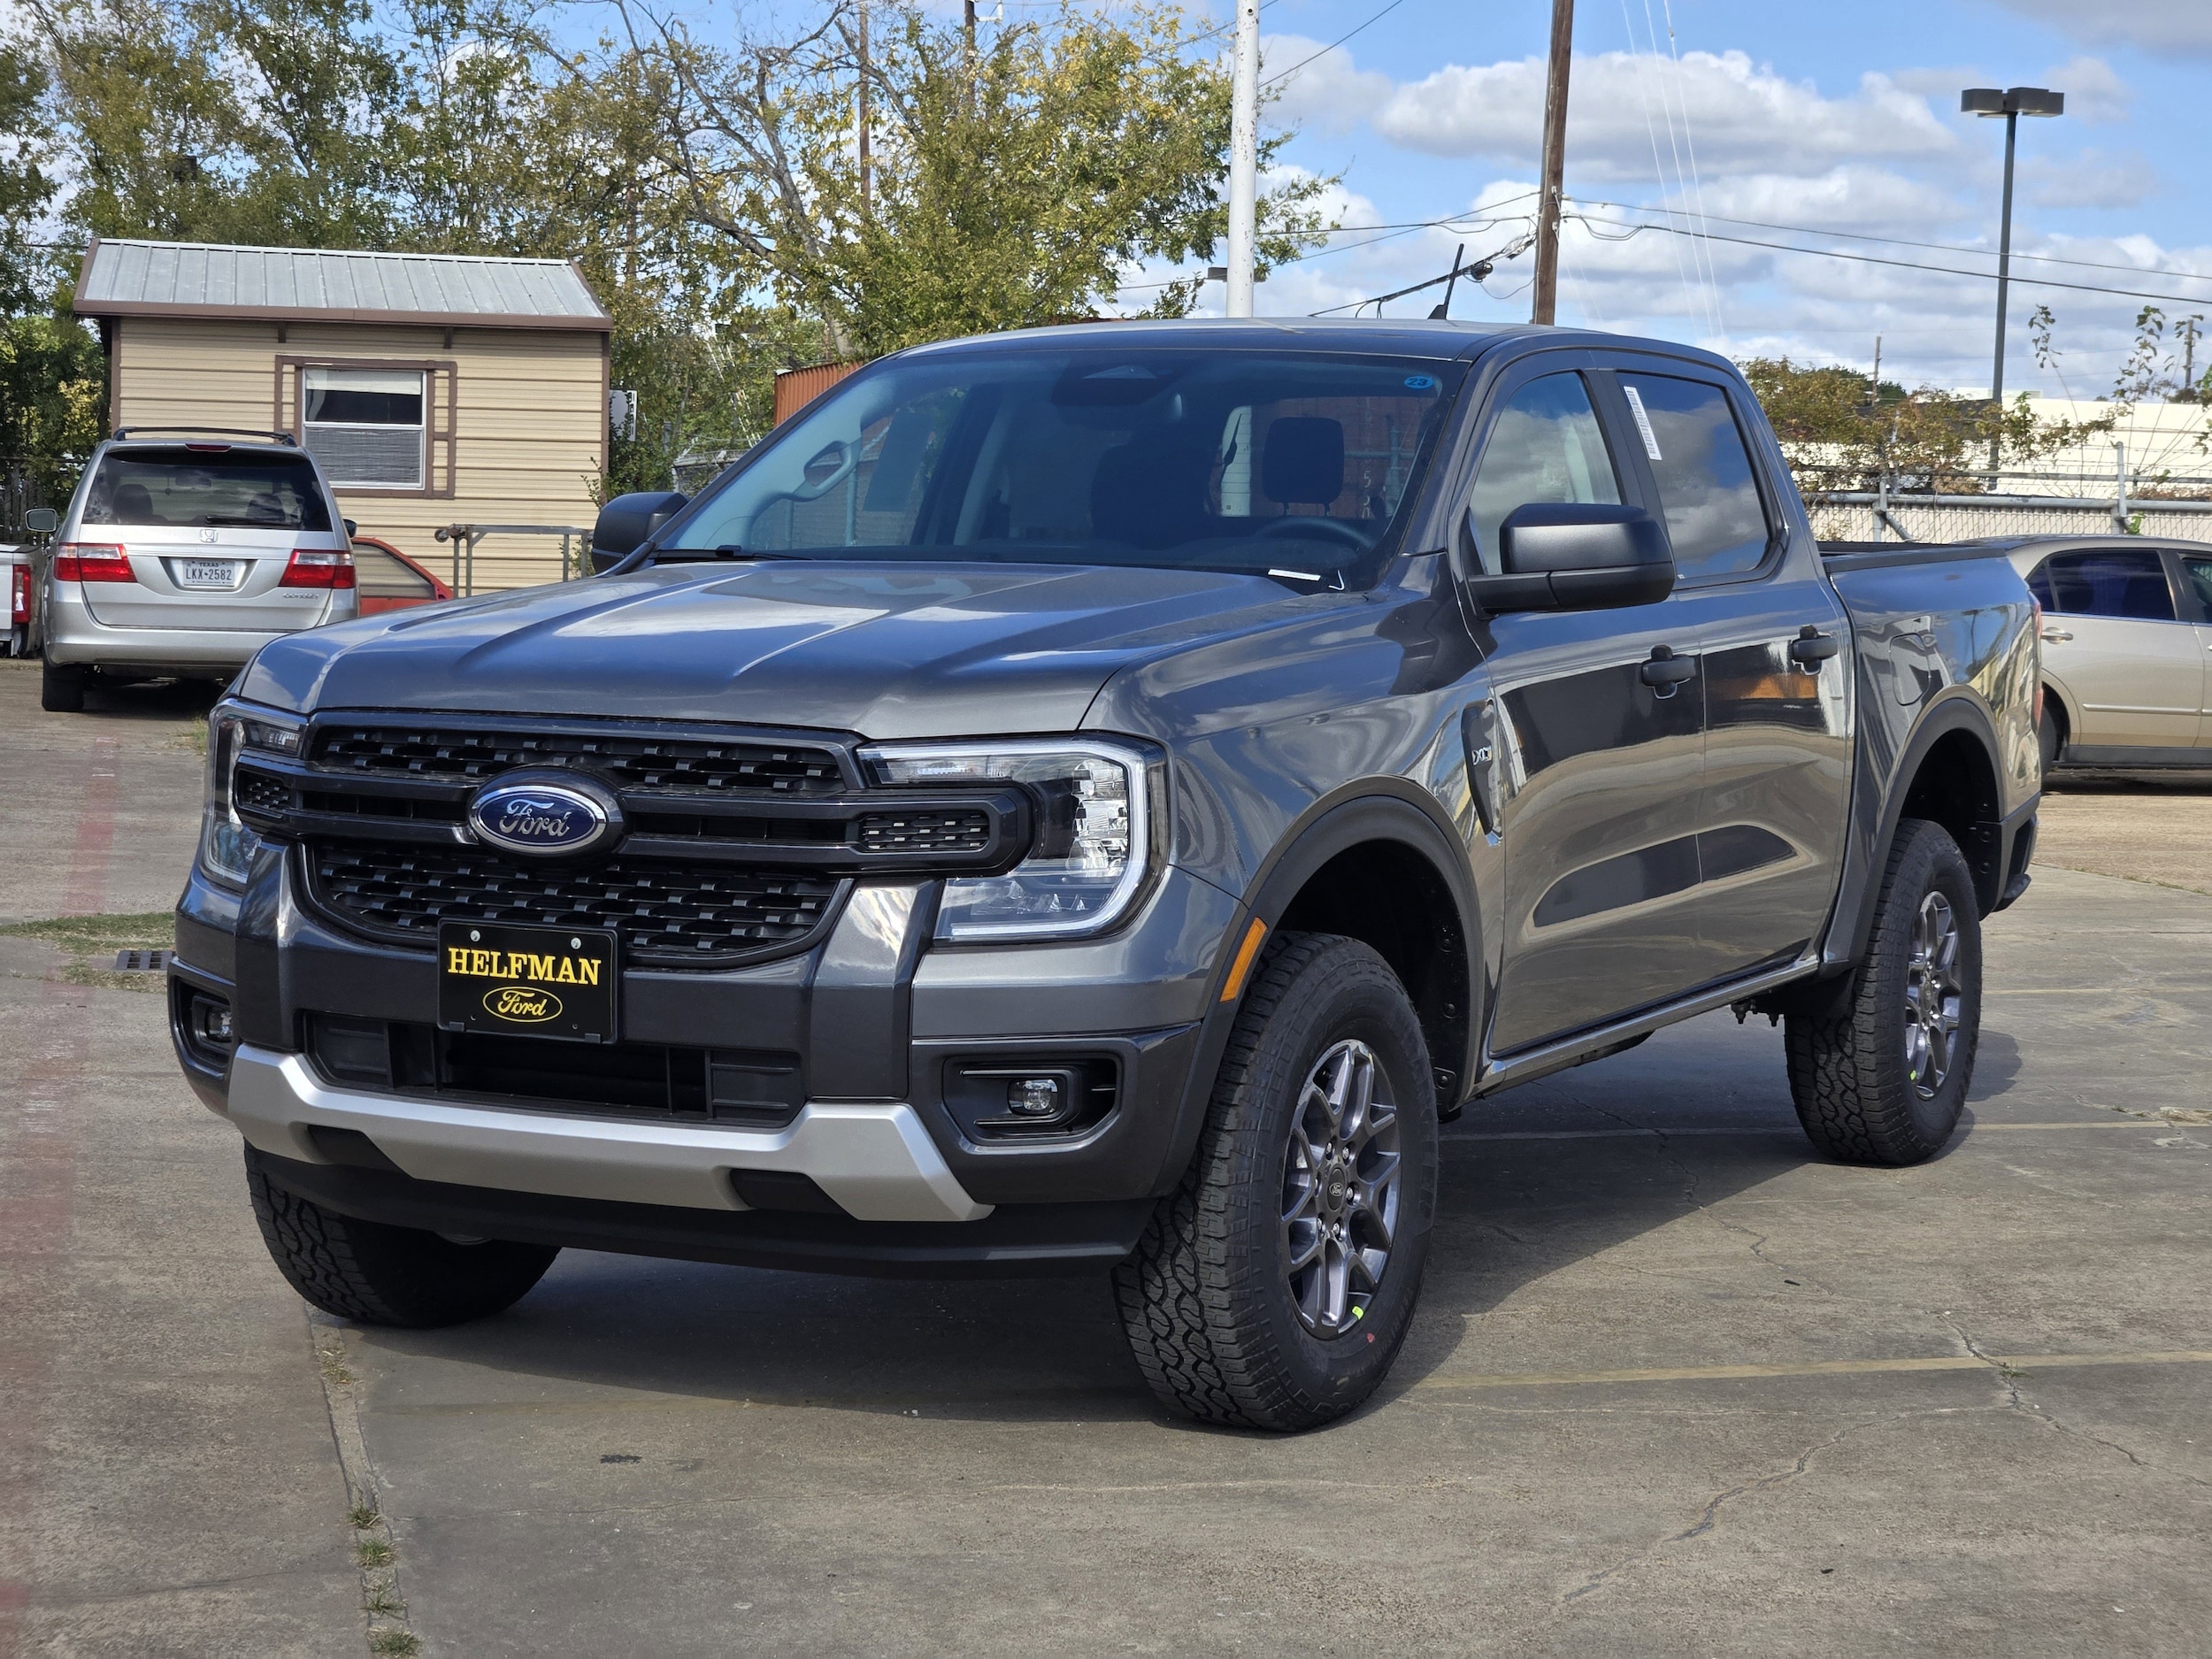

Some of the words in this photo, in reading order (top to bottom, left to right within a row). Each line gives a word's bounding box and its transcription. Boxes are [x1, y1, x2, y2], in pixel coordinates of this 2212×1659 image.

[1471, 745, 1492, 765] XLT
[498, 799, 572, 836] Ford
[448, 947, 602, 985] HELFMAN
[497, 989, 548, 1016] Ford
